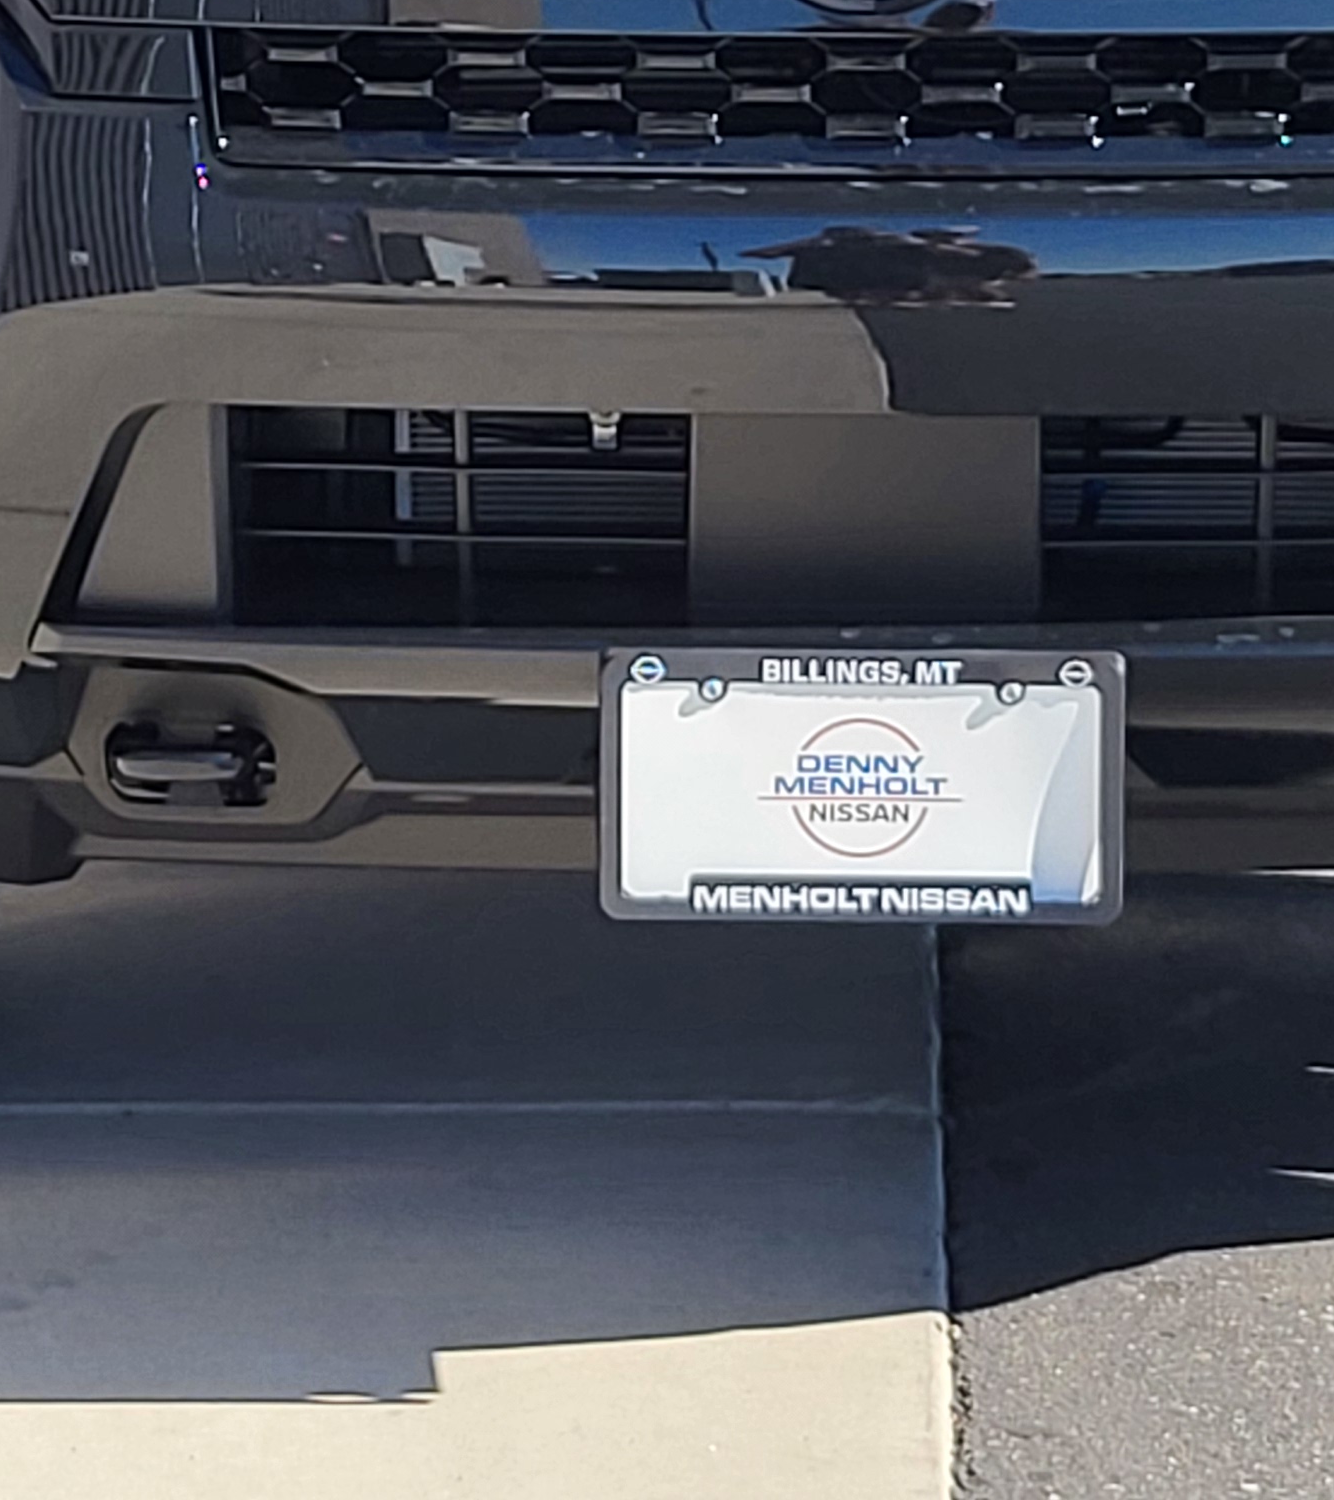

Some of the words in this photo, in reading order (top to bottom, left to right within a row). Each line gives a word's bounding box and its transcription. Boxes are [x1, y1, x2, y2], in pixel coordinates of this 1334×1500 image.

[762, 658, 910, 684] BILLINGS,
[915, 660, 962, 685] MT
[796, 754, 924, 774] DENNY
[773, 776, 948, 796] MENHOLT
[807, 802, 910, 823] NISSAN
[692, 884, 878, 912] MENHOLT
[880, 886, 1029, 915] NISSAN
